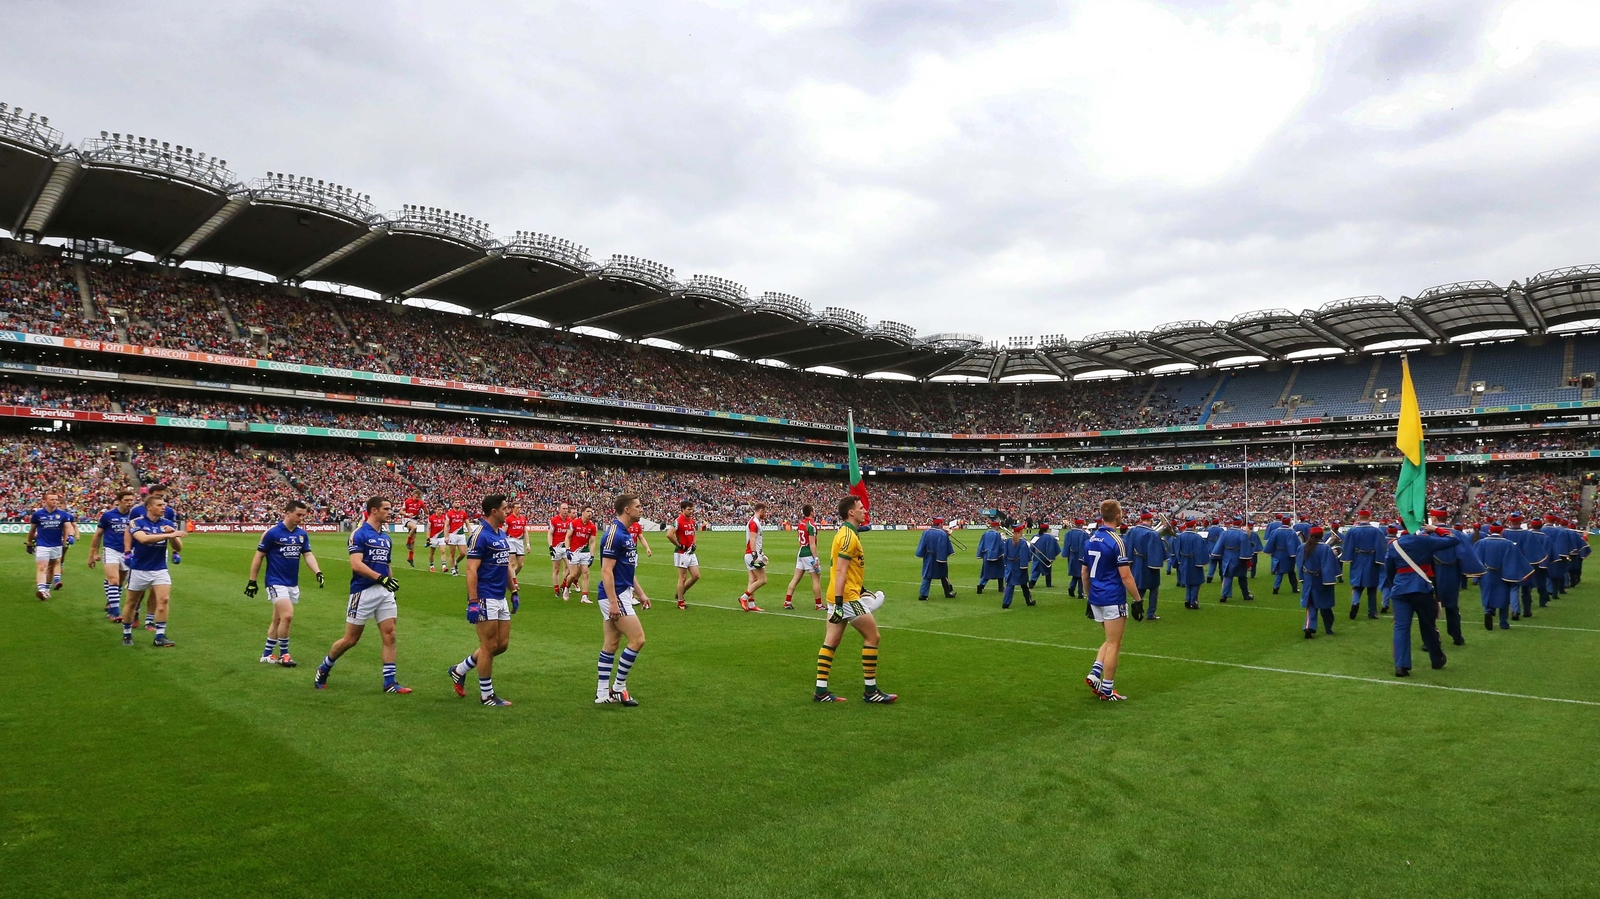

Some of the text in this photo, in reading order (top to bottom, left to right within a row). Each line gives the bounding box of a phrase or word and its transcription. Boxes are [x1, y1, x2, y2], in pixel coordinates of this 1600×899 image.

[0, 331, 17, 341] AA
[83, 341, 124, 352] eirom
[152, 349, 189, 359] eircom
[215, 356, 249, 366] eircom
[30, 408, 75, 418] SuperValu
[102, 413, 144, 422] SuperValu
[195, 524, 231, 532] SuperValu
[305, 524, 337, 532] SuperValu
[1088, 550, 1101, 578] 7
